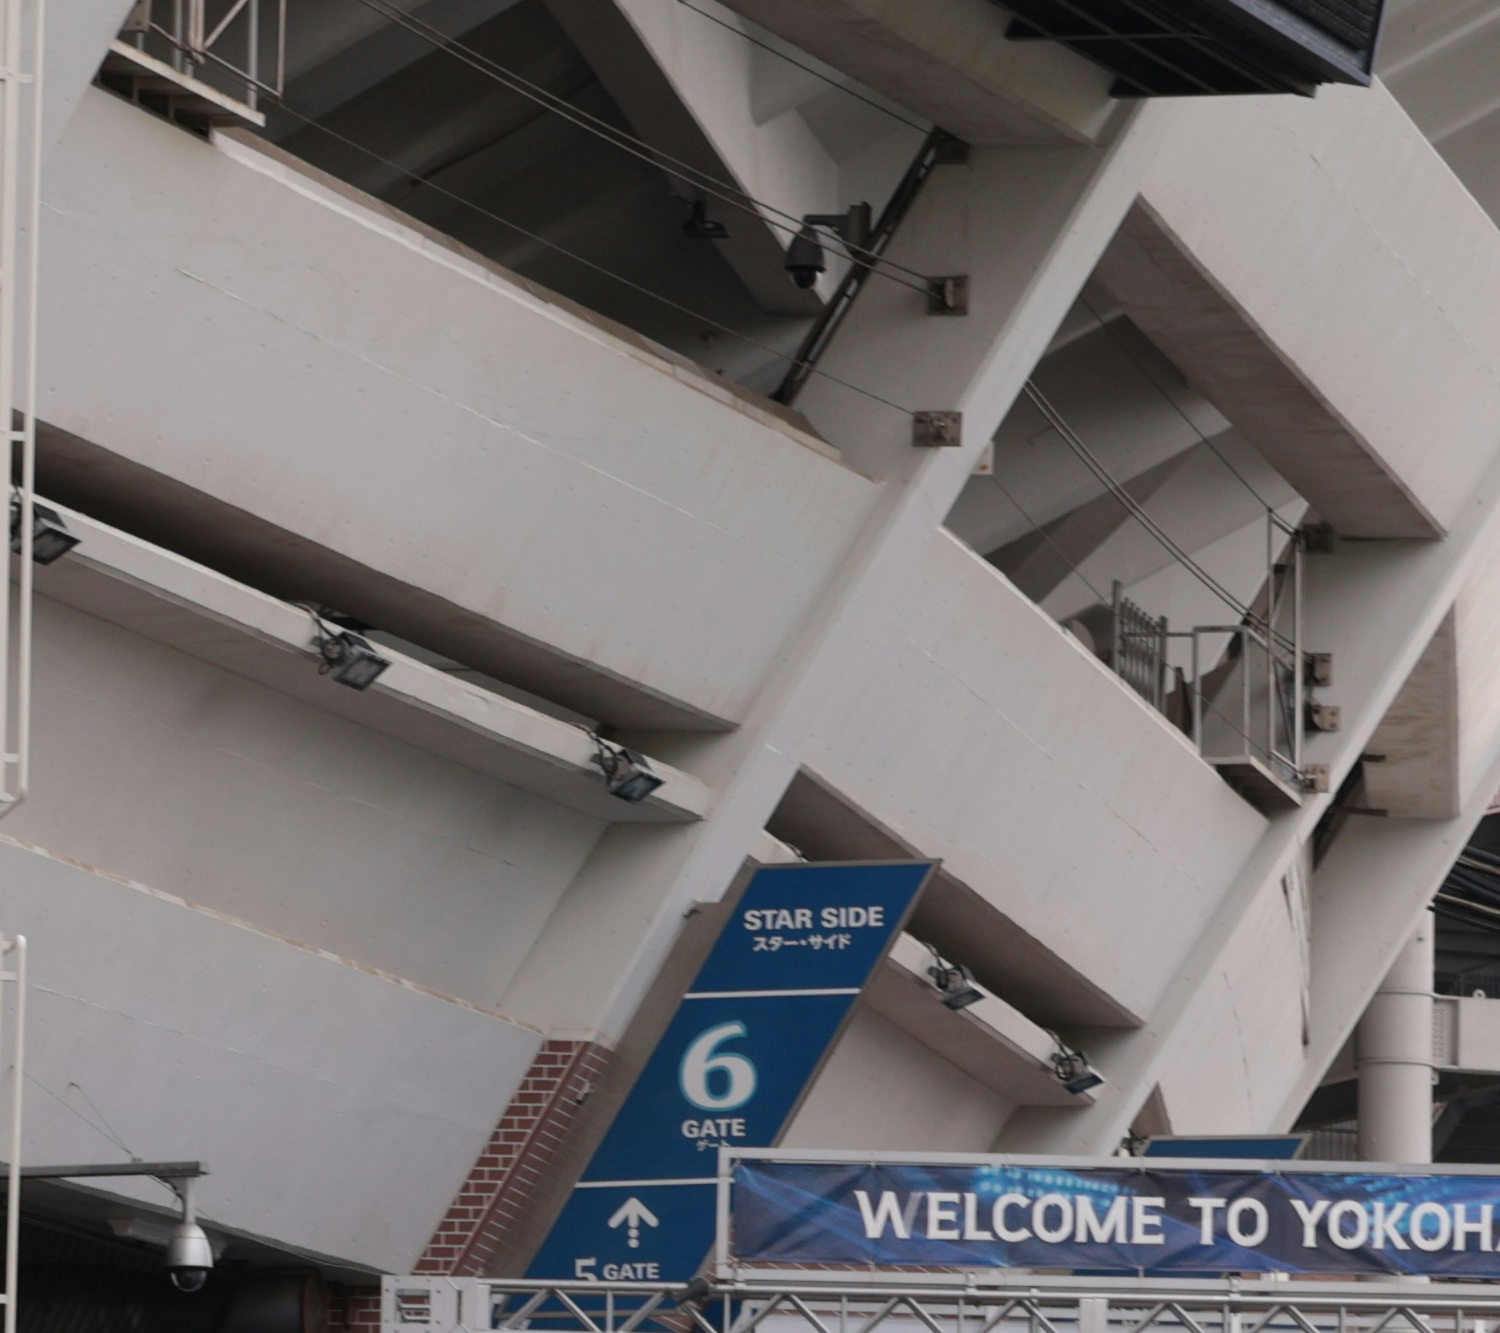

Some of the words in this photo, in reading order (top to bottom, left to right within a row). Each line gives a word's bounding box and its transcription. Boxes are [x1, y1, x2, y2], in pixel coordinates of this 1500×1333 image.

[743, 908, 813, 931] STAR
[820, 906, 885, 929] SIDE
[752, 933, 853, 952] スター・サイド
[679, 1020, 757, 1112] 6
[681, 1117, 747, 1139] GATE
[854, 1189, 1166, 1244] WELCOME
[1189, 1196, 1270, 1247] TO
[602, 1261, 661, 1281] GATE
